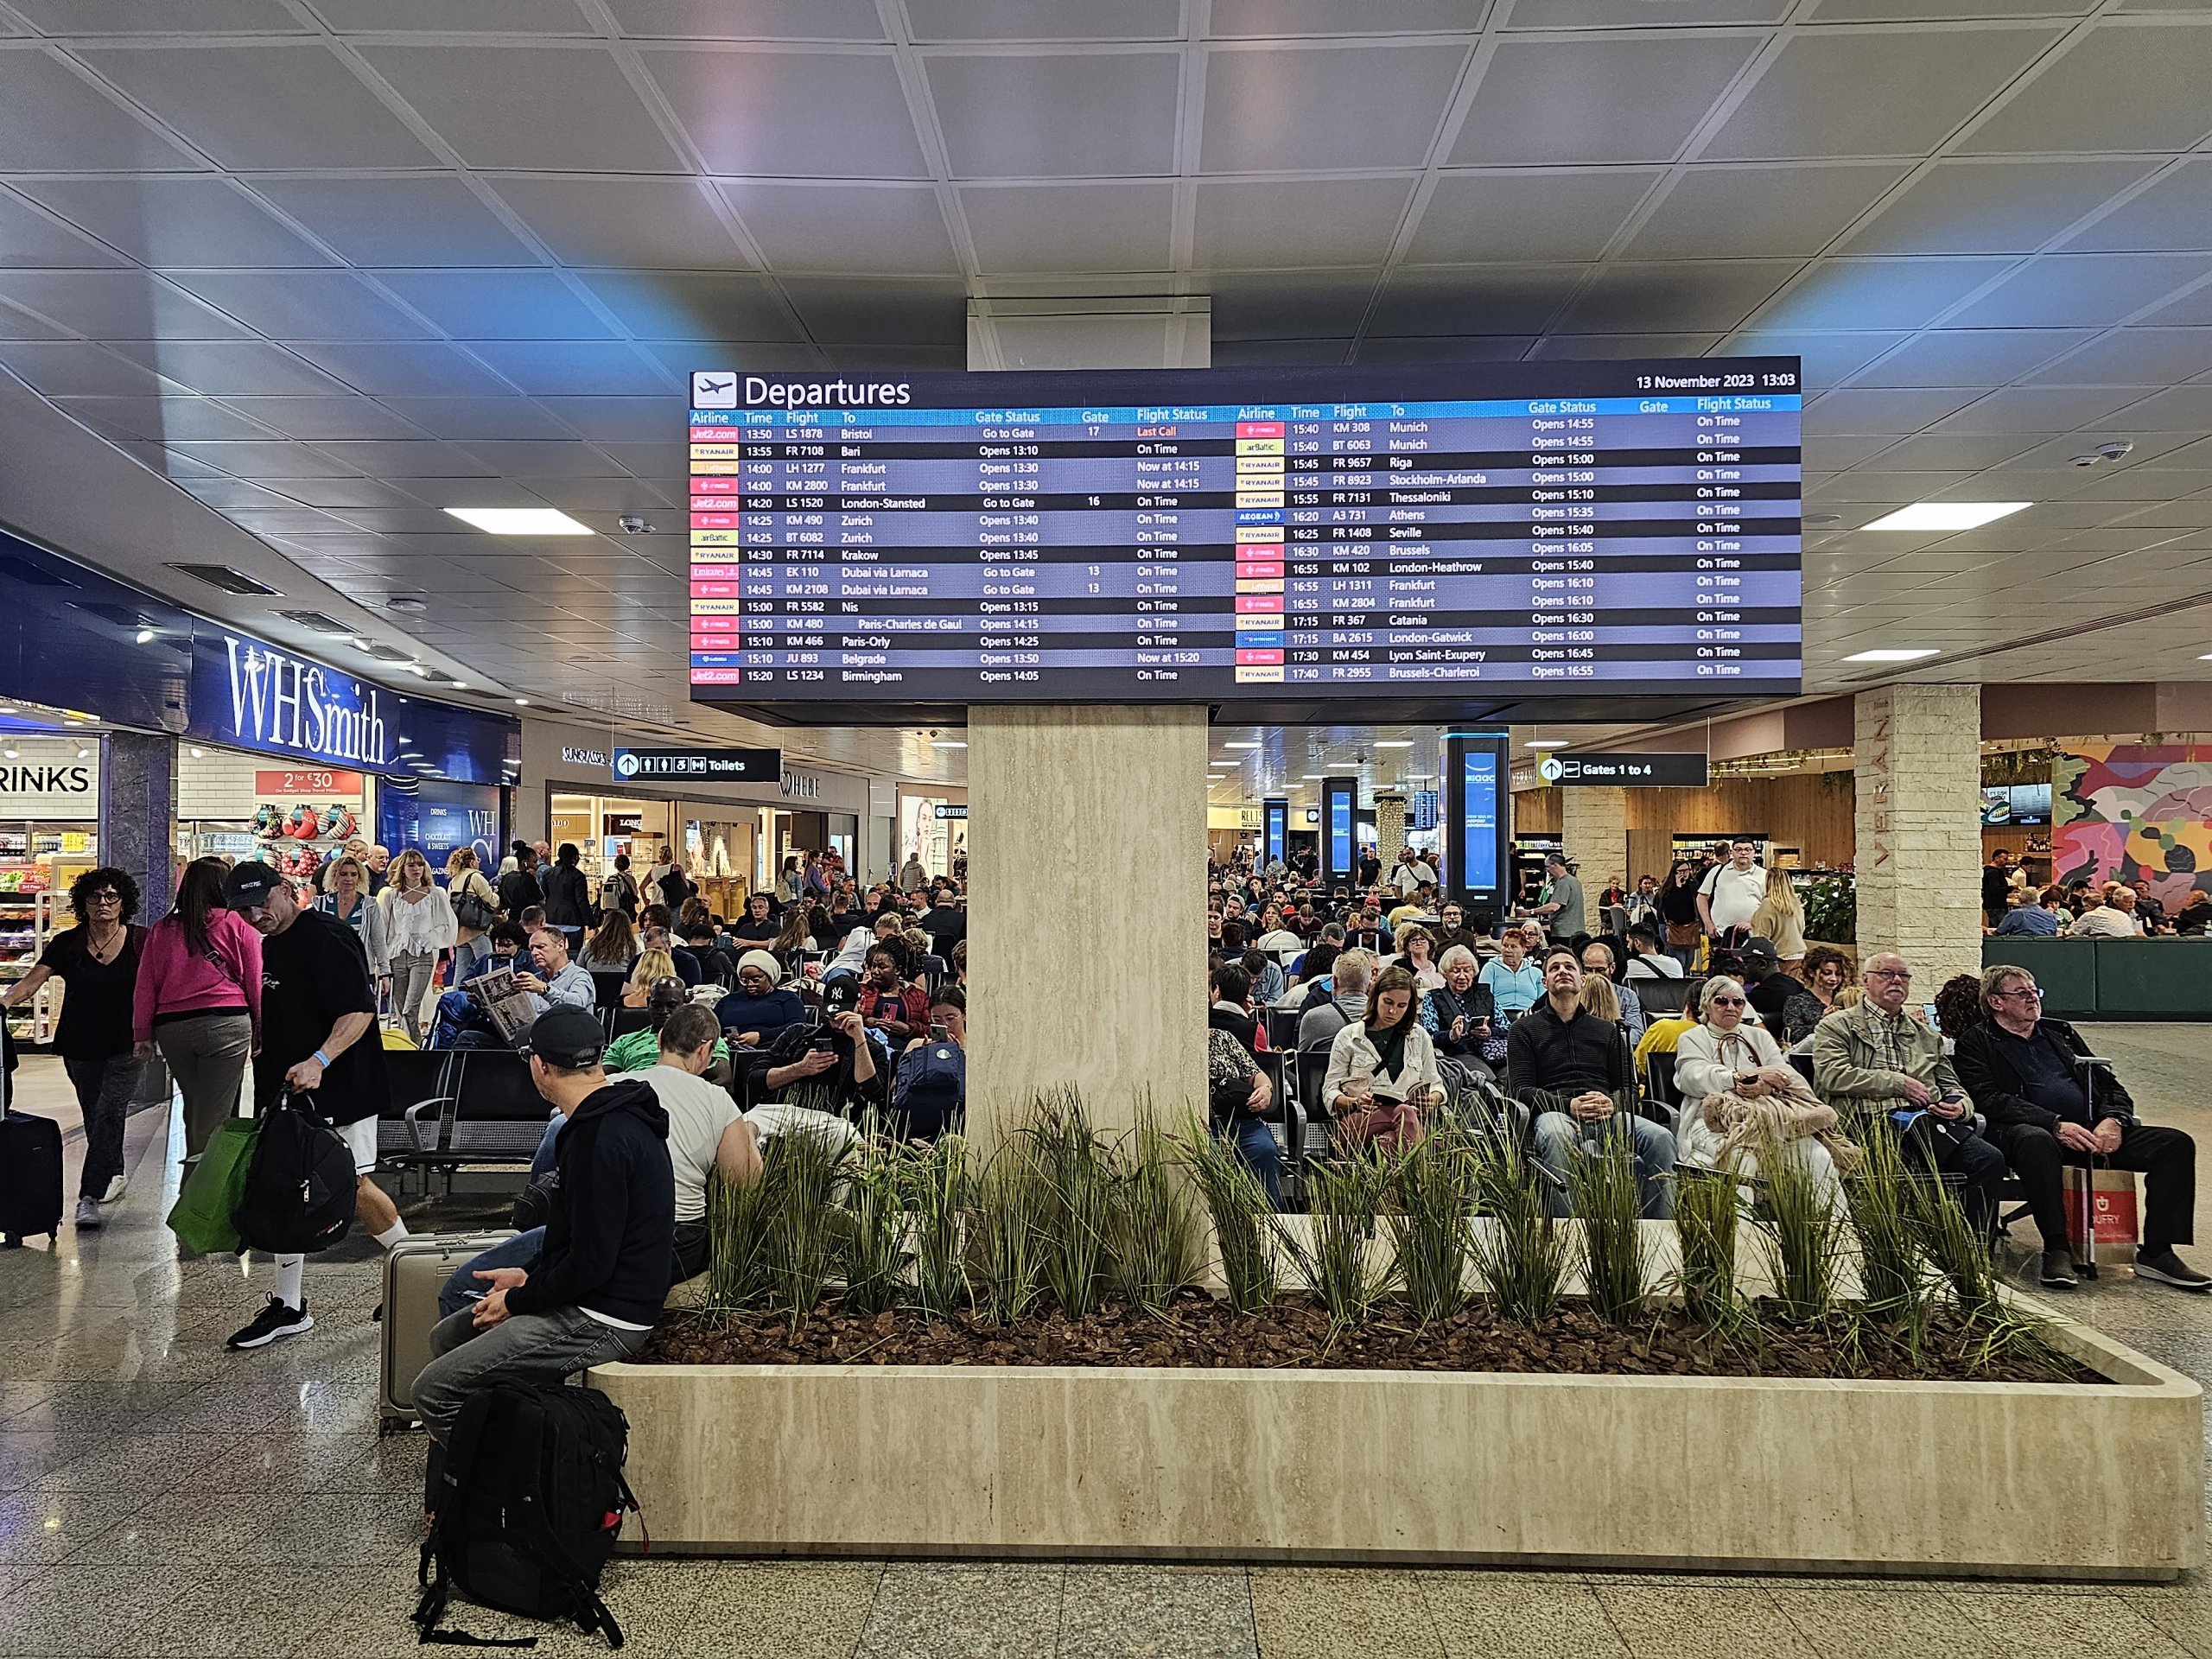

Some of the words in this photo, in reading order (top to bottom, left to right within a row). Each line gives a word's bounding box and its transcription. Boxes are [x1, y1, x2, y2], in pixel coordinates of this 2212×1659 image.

[1636, 376, 1653, 389] 13
[1655, 375, 1721, 389] November
[1723, 374, 1755, 387] 2023
[1761, 374, 1796, 387] 13:03
[745, 378, 911, 410] Departures
[1237, 407, 1275, 421] Airline
[1291, 407, 1320, 419] Time
[1333, 405, 1367, 419] Flight
[1389, 405, 1405, 416] To
[1529, 402, 1556, 414] Gate
[1559, 401, 1597, 413] Status
[1639, 401, 1669, 413] Gate
[1698, 397, 1732, 412] Flight
[1734, 397, 1772, 410] Status
[692, 412, 728, 424] Airline
[744, 412, 773, 424] Time
[786, 412, 818, 426] Flight
[842, 412, 855, 423] To
[976, 411, 1002, 423] Gate
[1005, 411, 1040, 423] Status
[1082, 411, 1109, 423] Gate
[1136, 410, 1171, 423] Flight
[1173, 409, 1208, 421] Status
[692, 429, 736, 440] Jet2.com
[747, 429, 772, 439] 13:50
[785, 428, 798, 439] LS
[799, 428, 823, 439] 1878
[841, 429, 873, 440] Bristol
[982, 428, 998, 439] Go
[999, 429, 1010, 439] to
[1011, 428, 1035, 438] Gate
[1088, 426, 1100, 436] 17
[1137, 427, 1157, 437] Last
[1158, 426, 1177, 436] Call
[747, 446, 772, 457] 13:55
[785, 446, 798, 456] FR
[799, 446, 824, 456] 7108
[841, 446, 861, 457] Bari
[979, 445, 1011, 459] Opens
[1013, 445, 1039, 456] 13:10
[1136, 444, 1152, 454] On
[1154, 443, 1178, 454] Time
[1293, 459, 1319, 469] 15:45
[1332, 457, 1346, 468] FR
[1347, 457, 1372, 468] 9657
[1389, 456, 1413, 471] Riga
[1532, 454, 1565, 467] Opens
[1567, 454, 1594, 464] 15:00
[1696, 452, 1713, 462] On
[1714, 451, 1741, 462] Time
[692, 498, 738, 509] Jet2.com
[747, 498, 772, 508] 14:20
[785, 498, 798, 508] LS
[800, 498, 823, 508] 1520
[841, 498, 926, 509] London-Stansted
[982, 498, 998, 508] Go
[999, 499, 1011, 508] to
[1012, 498, 1035, 508] Gate
[1088, 495, 1101, 506] 16
[1136, 496, 1152, 507] On
[1154, 496, 1178, 506] Time
[1293, 493, 1319, 505] 15:55
[1332, 493, 1346, 503] FR
[1347, 492, 1370, 503] 7131
[1389, 491, 1452, 503] Thessaloniki
[1532, 490, 1565, 503] Opens
[1567, 489, 1594, 499] 15:10
[1696, 487, 1713, 498] On
[1714, 486, 1741, 498] Time
[1239, 512, 1274, 521] AEGEAN
[1293, 511, 1319, 522] 16:20
[1332, 510, 1347, 521] A3
[1348, 510, 1366, 520] 731
[1389, 509, 1426, 521] Athens
[1532, 507, 1565, 520] Opens
[1567, 506, 1594, 518] 15:35
[1696, 505, 1713, 516] On
[1714, 504, 1740, 515] Time
[1293, 563, 1319, 575] 16:55
[1332, 563, 1350, 573] KM
[1352, 563, 1370, 573] 102
[1389, 561, 1483, 573] London-Heathrow
[1531, 560, 1565, 573] Opens
[1567, 559, 1594, 570] 15:40
[1696, 558, 1713, 569] On
[1713, 557, 1740, 569] Time
[747, 636, 773, 646] 15:10
[786, 636, 804, 646] KM
[804, 636, 824, 646] 466
[842, 636, 891, 650] Paris-Orly
[980, 636, 1012, 649] Opens
[1013, 636, 1039, 646] 14:25
[1136, 635, 1153, 645] On
[1153, 635, 1178, 645] Time
[1293, 651, 1319, 662] 17:30
[1332, 650, 1350, 660] KM
[1351, 650, 1370, 660] 454
[1389, 650, 1414, 664] Lyon
[1415, 649, 1486, 663] Saint-Exupery
[1531, 648, 1565, 661] Opens
[1567, 648, 1594, 658] 16:45
[1696, 646, 1713, 658] On
[1713, 646, 1741, 657] Time
[693, 671, 737, 681] Jet2.com
[747, 671, 773, 681] 15:20
[786, 670, 798, 681] LS
[800, 670, 824, 681] 1234
[842, 671, 903, 684] Birmingham
[980, 671, 1012, 683] Opens
[1014, 671, 1039, 681] 14:05
[1136, 670, 1153, 680] On
[1154, 669, 1178, 680] Time
[224, 635, 385, 765] WHSmith
[709, 760, 746, 772] Toilets
[1583, 765, 1616, 776] Gates
[1618, 765, 1625, 776] 1
[1628, 766, 1642, 776] to
[1643, 765, 1652, 776] 4
[284, 772, 294, 788] 2
[307, 772, 333, 788] €30
[430, 808, 448, 817] DRINKS
[467, 810, 497, 836] WH
[425, 833, 452, 842] CHOCOLATE
[431, 867, 450, 875] GAZINE
